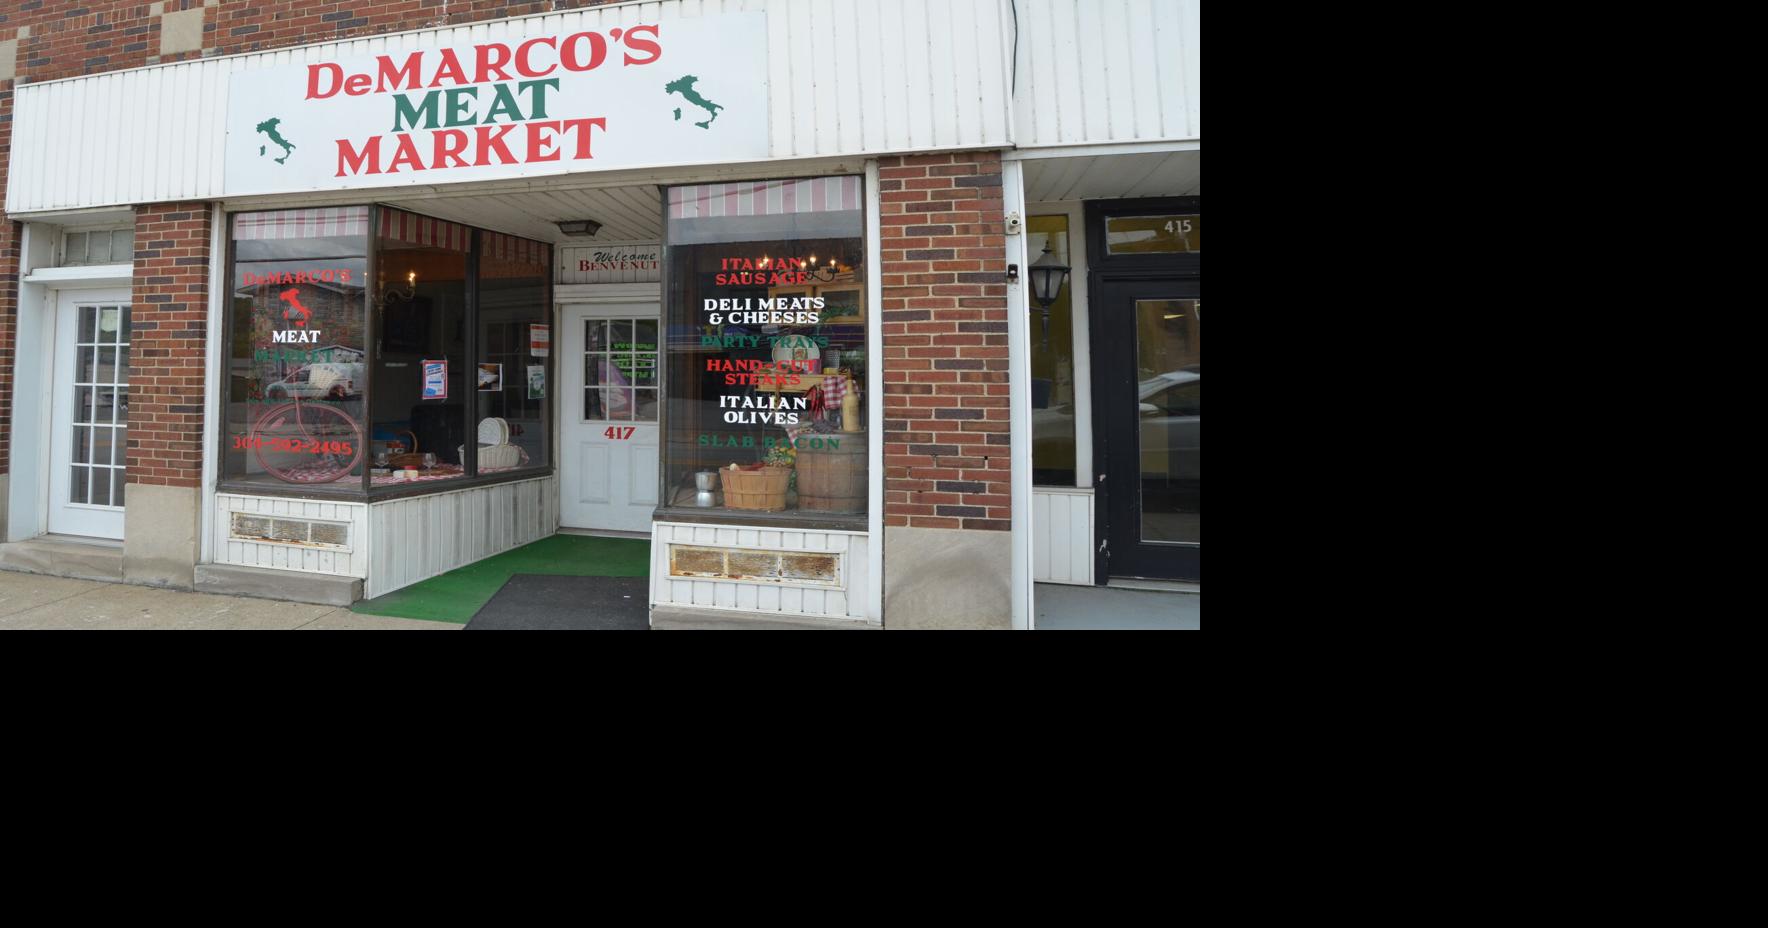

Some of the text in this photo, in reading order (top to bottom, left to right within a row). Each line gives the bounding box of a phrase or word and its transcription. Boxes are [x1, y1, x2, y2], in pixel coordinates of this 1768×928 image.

[305, 24, 662, 100] DeMARCO'S
[391, 78, 560, 132] MEAT
[334, 117, 606, 178] MARKET
[1164, 219, 1192, 234] 415
[593, 250, 656, 262] Welcome
[721, 256, 802, 270] ITALIAN
[715, 272, 809, 286] SAUSAGE
[704, 296, 825, 311] DELI MEATS
[709, 311, 820, 325] & CHEESES
[272, 329, 321, 343] MEAT
[701, 335, 829, 349] PARTY TRAYS
[706, 359, 818, 372] HAND-CUT
[725, 373, 801, 386] STEAKS
[720, 395, 808, 410] ITALIAN
[724, 411, 799, 425] OLIVES
[604, 426, 636, 440] 417
[697, 434, 840, 450] SLAB BACON
